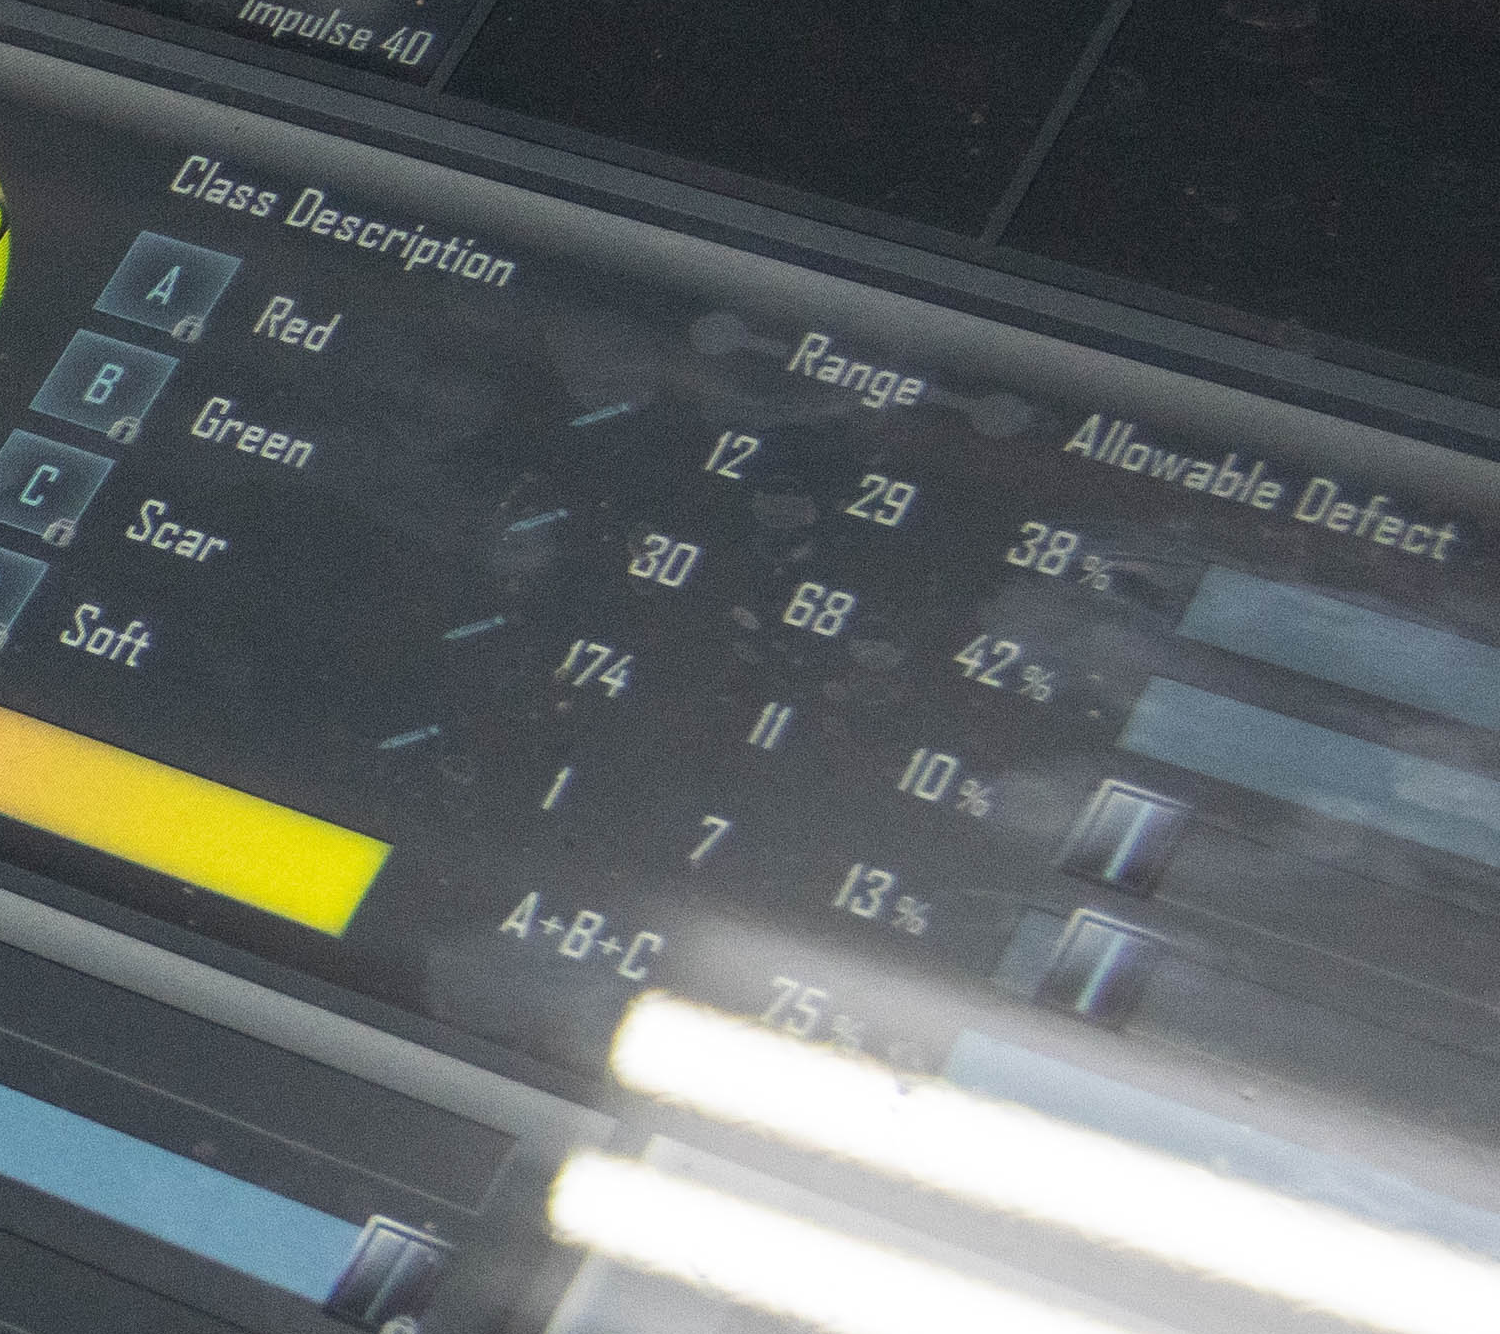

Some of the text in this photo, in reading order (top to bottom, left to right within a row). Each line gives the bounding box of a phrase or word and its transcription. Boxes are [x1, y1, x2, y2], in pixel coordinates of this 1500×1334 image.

[379, 28, 431, 67] 40
[170, 155, 517, 288] Class Description
[146, 265, 342, 352] A Red
[84, 363, 315, 468] B Green
[785, 332, 926, 410] Range
[19, 465, 228, 562] C Scar
[703, 431, 762, 480] 12
[844, 474, 917, 528] 29
[1064, 413, 1460, 563] Allowable Defect
[628, 533, 701, 588] 30
[782, 582, 855, 637] 68
[60, 603, 151, 668] Soft
[554, 638, 635, 700] 174
[748, 702, 792, 749] 11
[688, 815, 732, 861] 7
